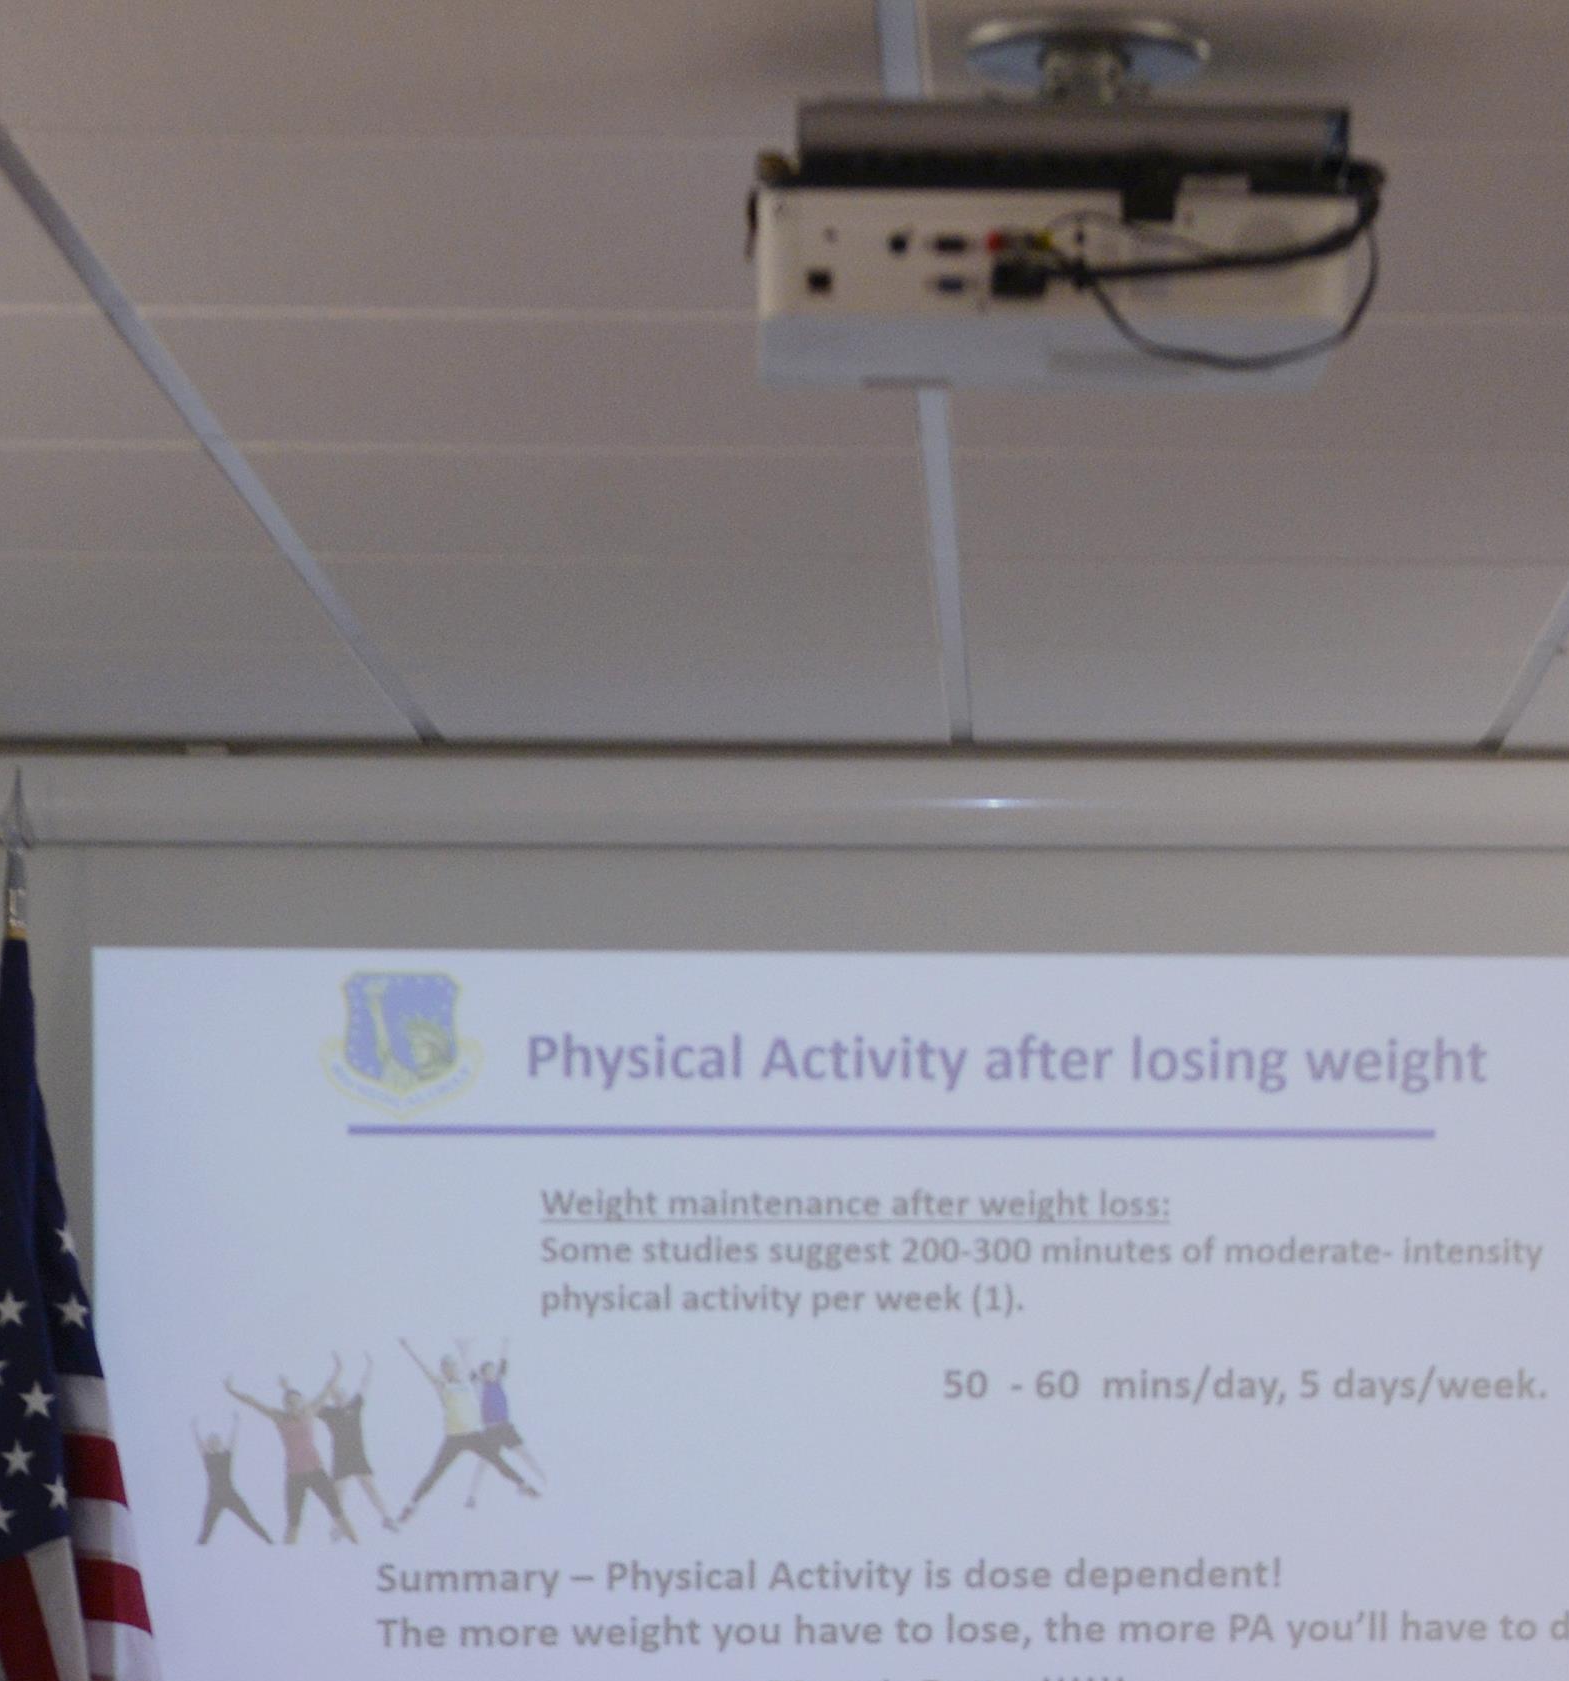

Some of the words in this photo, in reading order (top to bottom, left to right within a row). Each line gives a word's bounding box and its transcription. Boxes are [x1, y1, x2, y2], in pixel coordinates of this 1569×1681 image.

[527, 1031, 743, 1091] Physical
[760, 1034, 969, 1093] Activity
[984, 1032, 1114, 1082] after
[1131, 1034, 1288, 1095] losing
[1304, 1036, 1488, 1095] weight
[539, 1187, 657, 1224] Weight
[668, 1189, 882, 1222] maintenance
[890, 1188, 970, 1222] after
[980, 1188, 1089, 1224] weight
[1099, 1189, 1171, 1224] loss:
[540, 1235, 633, 1264] Some
[642, 1234, 759, 1264] studies
[769, 1238, 891, 1272] suggest
[902, 1236, 1032, 1264] 200-300
[1041, 1236, 1173, 1265] minutes
[1181, 1234, 1217, 1266] of
[1224, 1235, 1393, 1265] moderate-
[1403, 1236, 1544, 1273] intensity
[540, 1282, 673, 1319] physical
[681, 1283, 803, 1319] activity
[811, 1290, 866, 1319] per
[874, 1283, 962, 1313] week
[971, 1283, 1024, 1319] (1).
[943, 1368, 989, 1401] 50
[1034, 1368, 1081, 1401] 60
[1102, 1364, 1287, 1407] mins/day,
[1299, 1368, 1321, 1400] 5
[1332, 1364, 1548, 1407] days/week.
[376, 1562, 561, 1600] Summary
[606, 1558, 757, 1599] Physical
[767, 1558, 913, 1598] Activity
[924, 1558, 952, 1590] is
[963, 1557, 1053, 1590] dose
[1063, 1556, 1282, 1596] dependent!
[375, 1615, 448, 1649] The
[458, 1624, 560, 1648] more
[571, 1613, 702, 1654] weight
[711, 1622, 782, 1654] you
[794, 1613, 884, 1646] have
[894, 1617, 934, 1645] to
[945, 1611, 1032, 1650] lose,
[1043, 1611, 1107, 1644] the
[1118, 1620, 1216, 1644] more
[1228, 1612, 1275, 1643] PA
[1400, 1609, 1489, 1642] have
[1498, 1614, 1538, 1642] to
